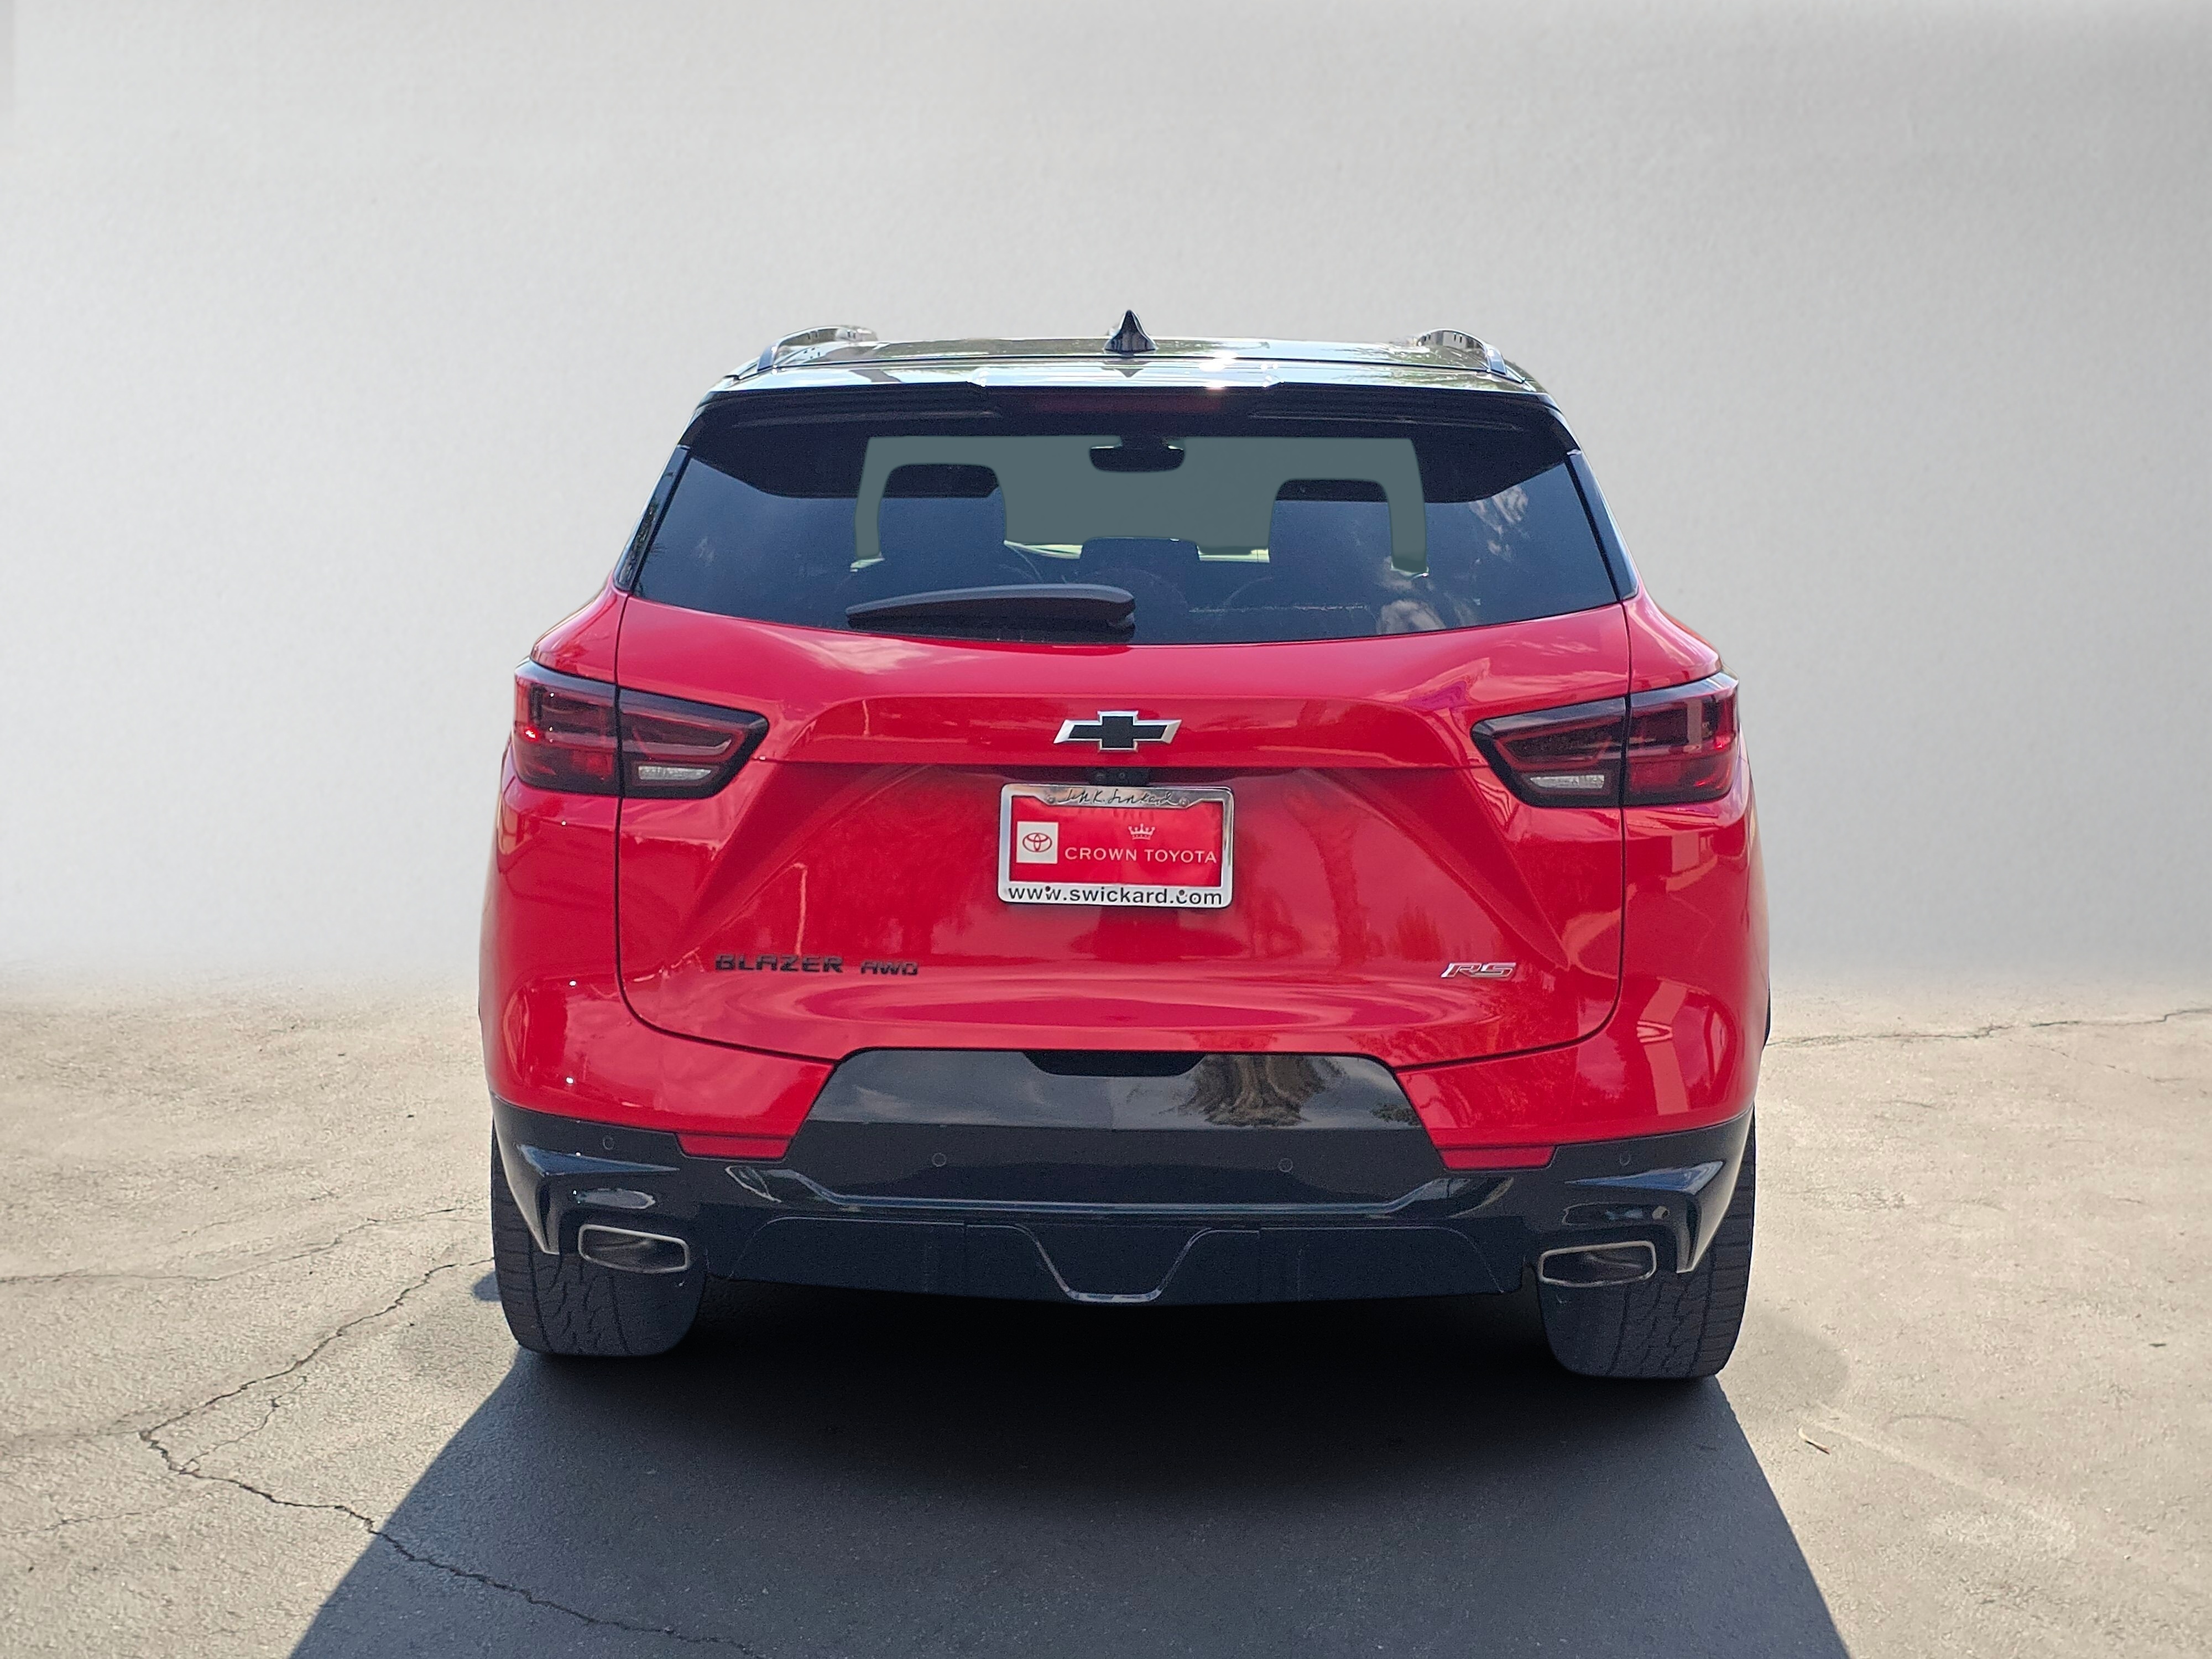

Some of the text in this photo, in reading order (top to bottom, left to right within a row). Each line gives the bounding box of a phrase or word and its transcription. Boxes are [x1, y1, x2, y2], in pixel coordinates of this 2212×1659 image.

[1065, 847, 1217, 864] CROWN TOYOTA
[1008, 886, 1222, 905] www.swickard.com
[715, 954, 919, 975] BLAZER AWD
[1441, 962, 1517, 978] RS
